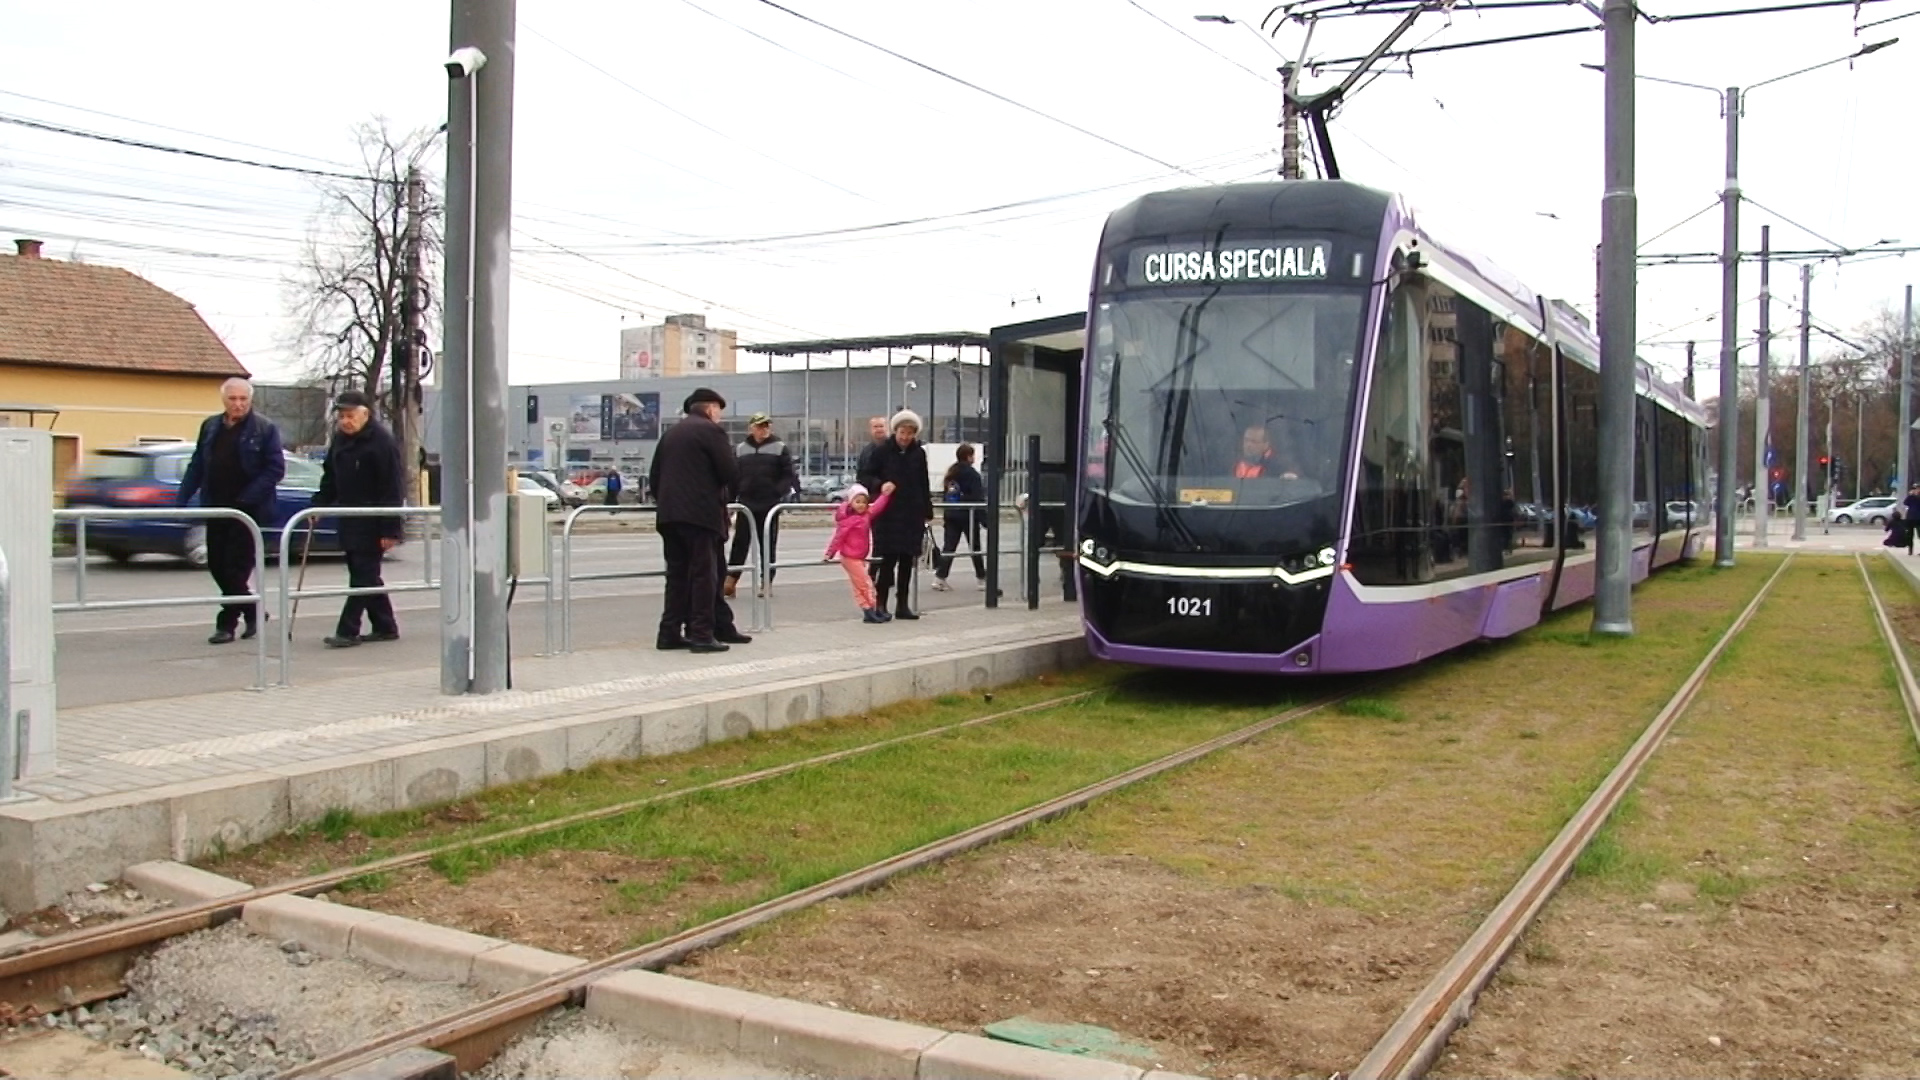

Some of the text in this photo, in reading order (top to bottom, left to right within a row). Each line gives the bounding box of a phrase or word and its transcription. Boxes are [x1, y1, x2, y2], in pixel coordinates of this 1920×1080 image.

[1145, 246, 1326, 282] CURSA SPECIALA
[1167, 597, 1211, 616] 1021
